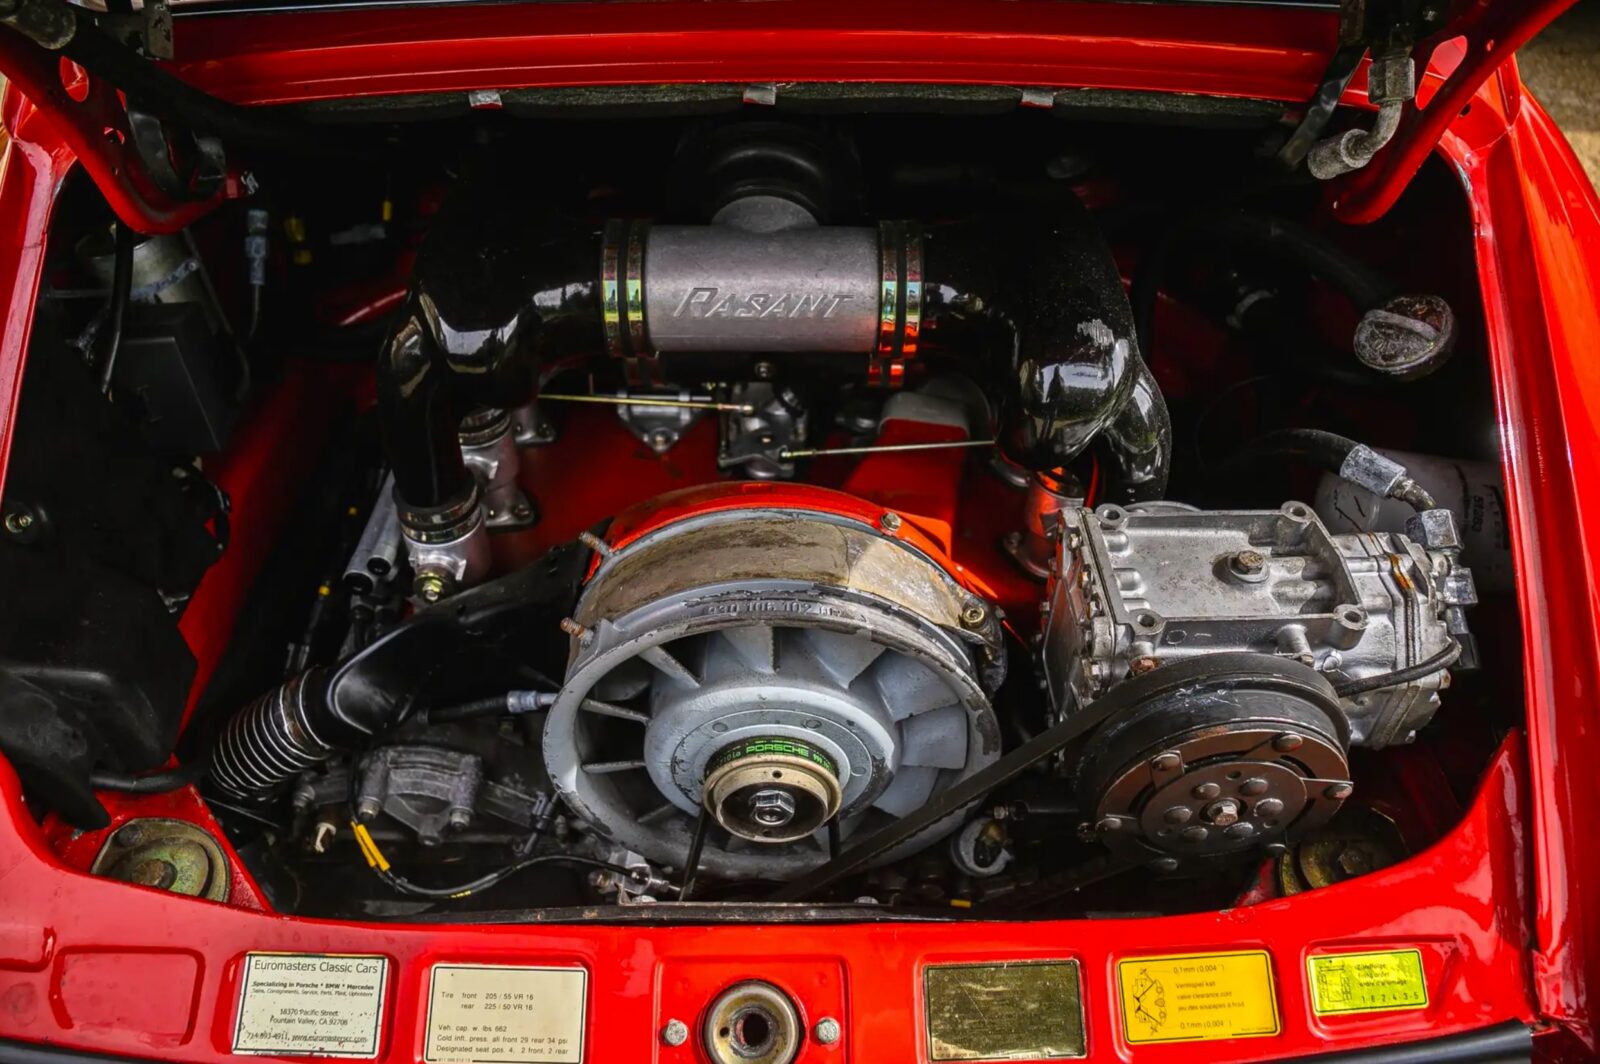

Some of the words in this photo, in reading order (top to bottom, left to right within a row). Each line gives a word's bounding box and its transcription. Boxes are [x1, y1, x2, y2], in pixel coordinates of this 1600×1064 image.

[745, 743, 809, 757] PORSCHE
[254, 960, 316, 972] Euromasters
[319, 961, 352, 973] Classic
[356, 963, 378, 974] Cars
[485, 992, 497, 1000] 205
[526, 993, 534, 1001] 16
[502, 1003, 512, 1011] 50
[299, 1008, 318, 1016] Pacific
[320, 1009, 339, 1017] Street
[270, 1016, 296, 1024] Fountain
[298, 1017, 317, 1026] Valley,
[494, 1025, 508, 1033] 662
[520, 1036, 529, 1044] 29
[436, 1045, 473, 1053] Designated
